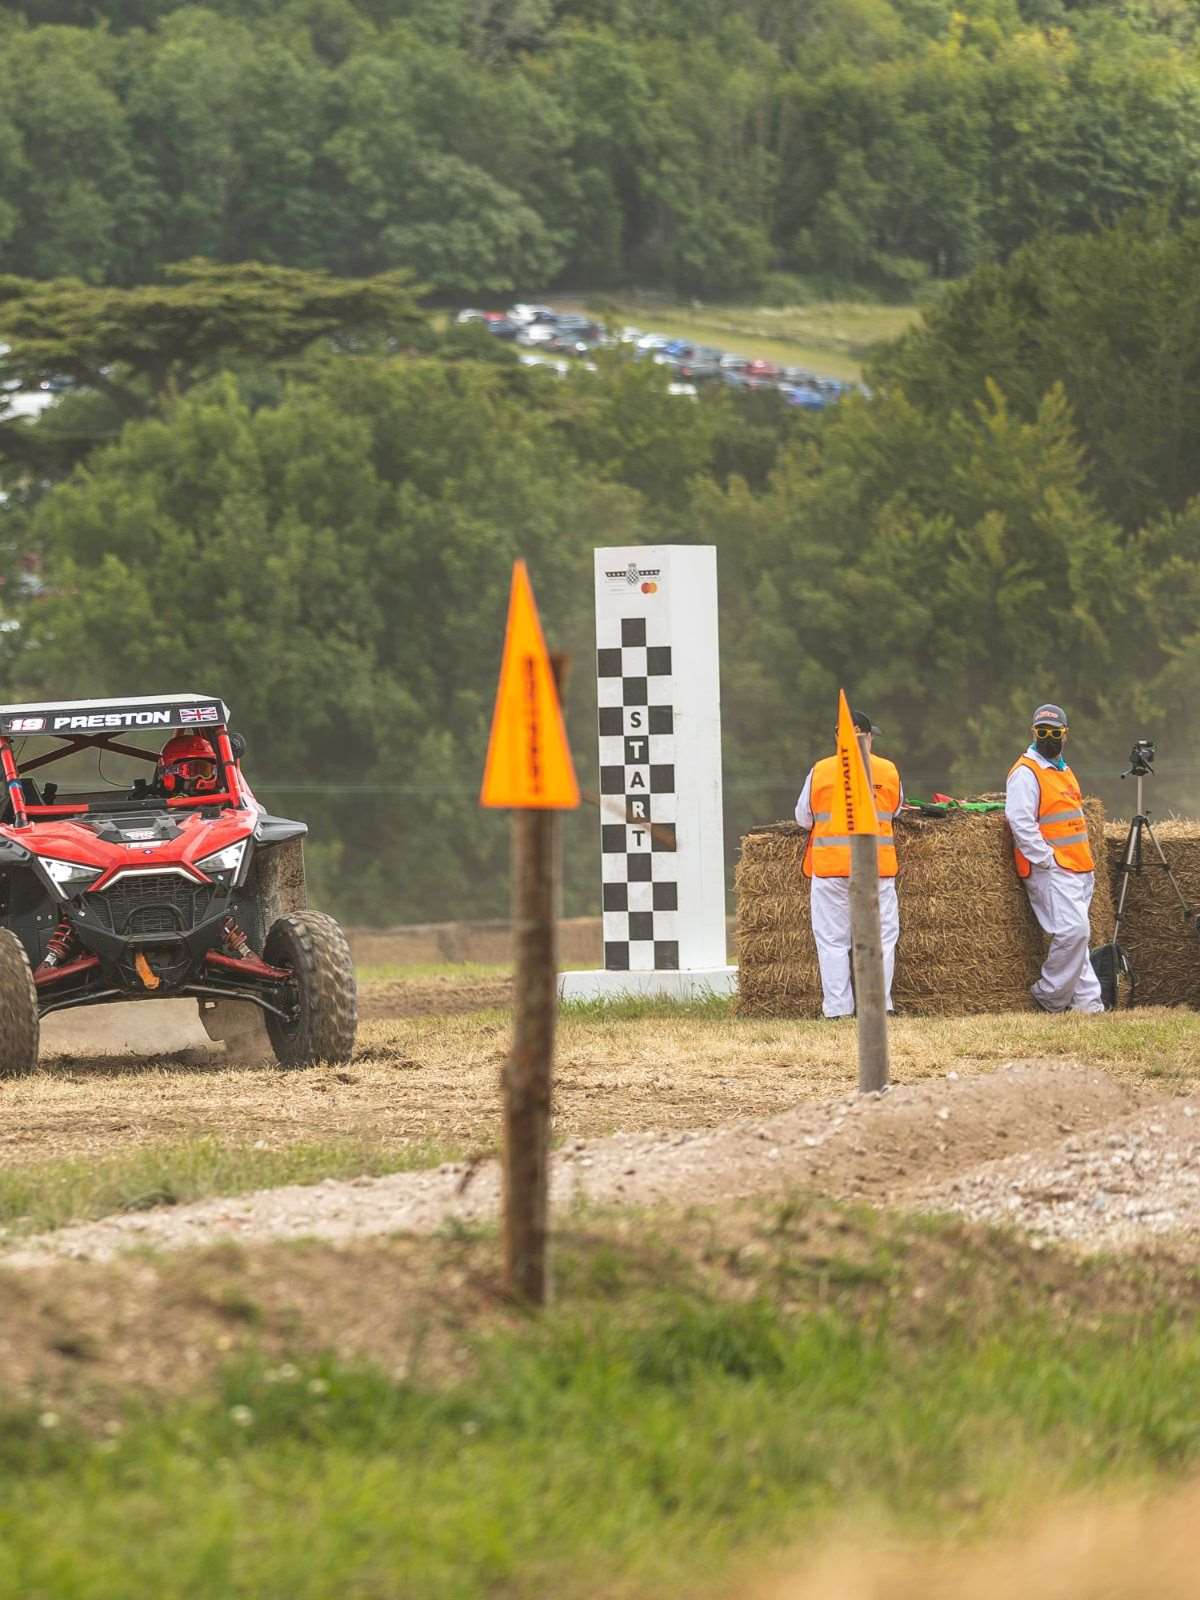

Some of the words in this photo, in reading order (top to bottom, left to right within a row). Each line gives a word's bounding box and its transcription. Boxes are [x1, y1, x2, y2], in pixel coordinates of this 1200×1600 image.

[10, 718, 46, 731] 19
[54, 711, 171, 729] PRESTON
[629, 711, 647, 847] START
[841, 745, 855, 831] BRITPART
